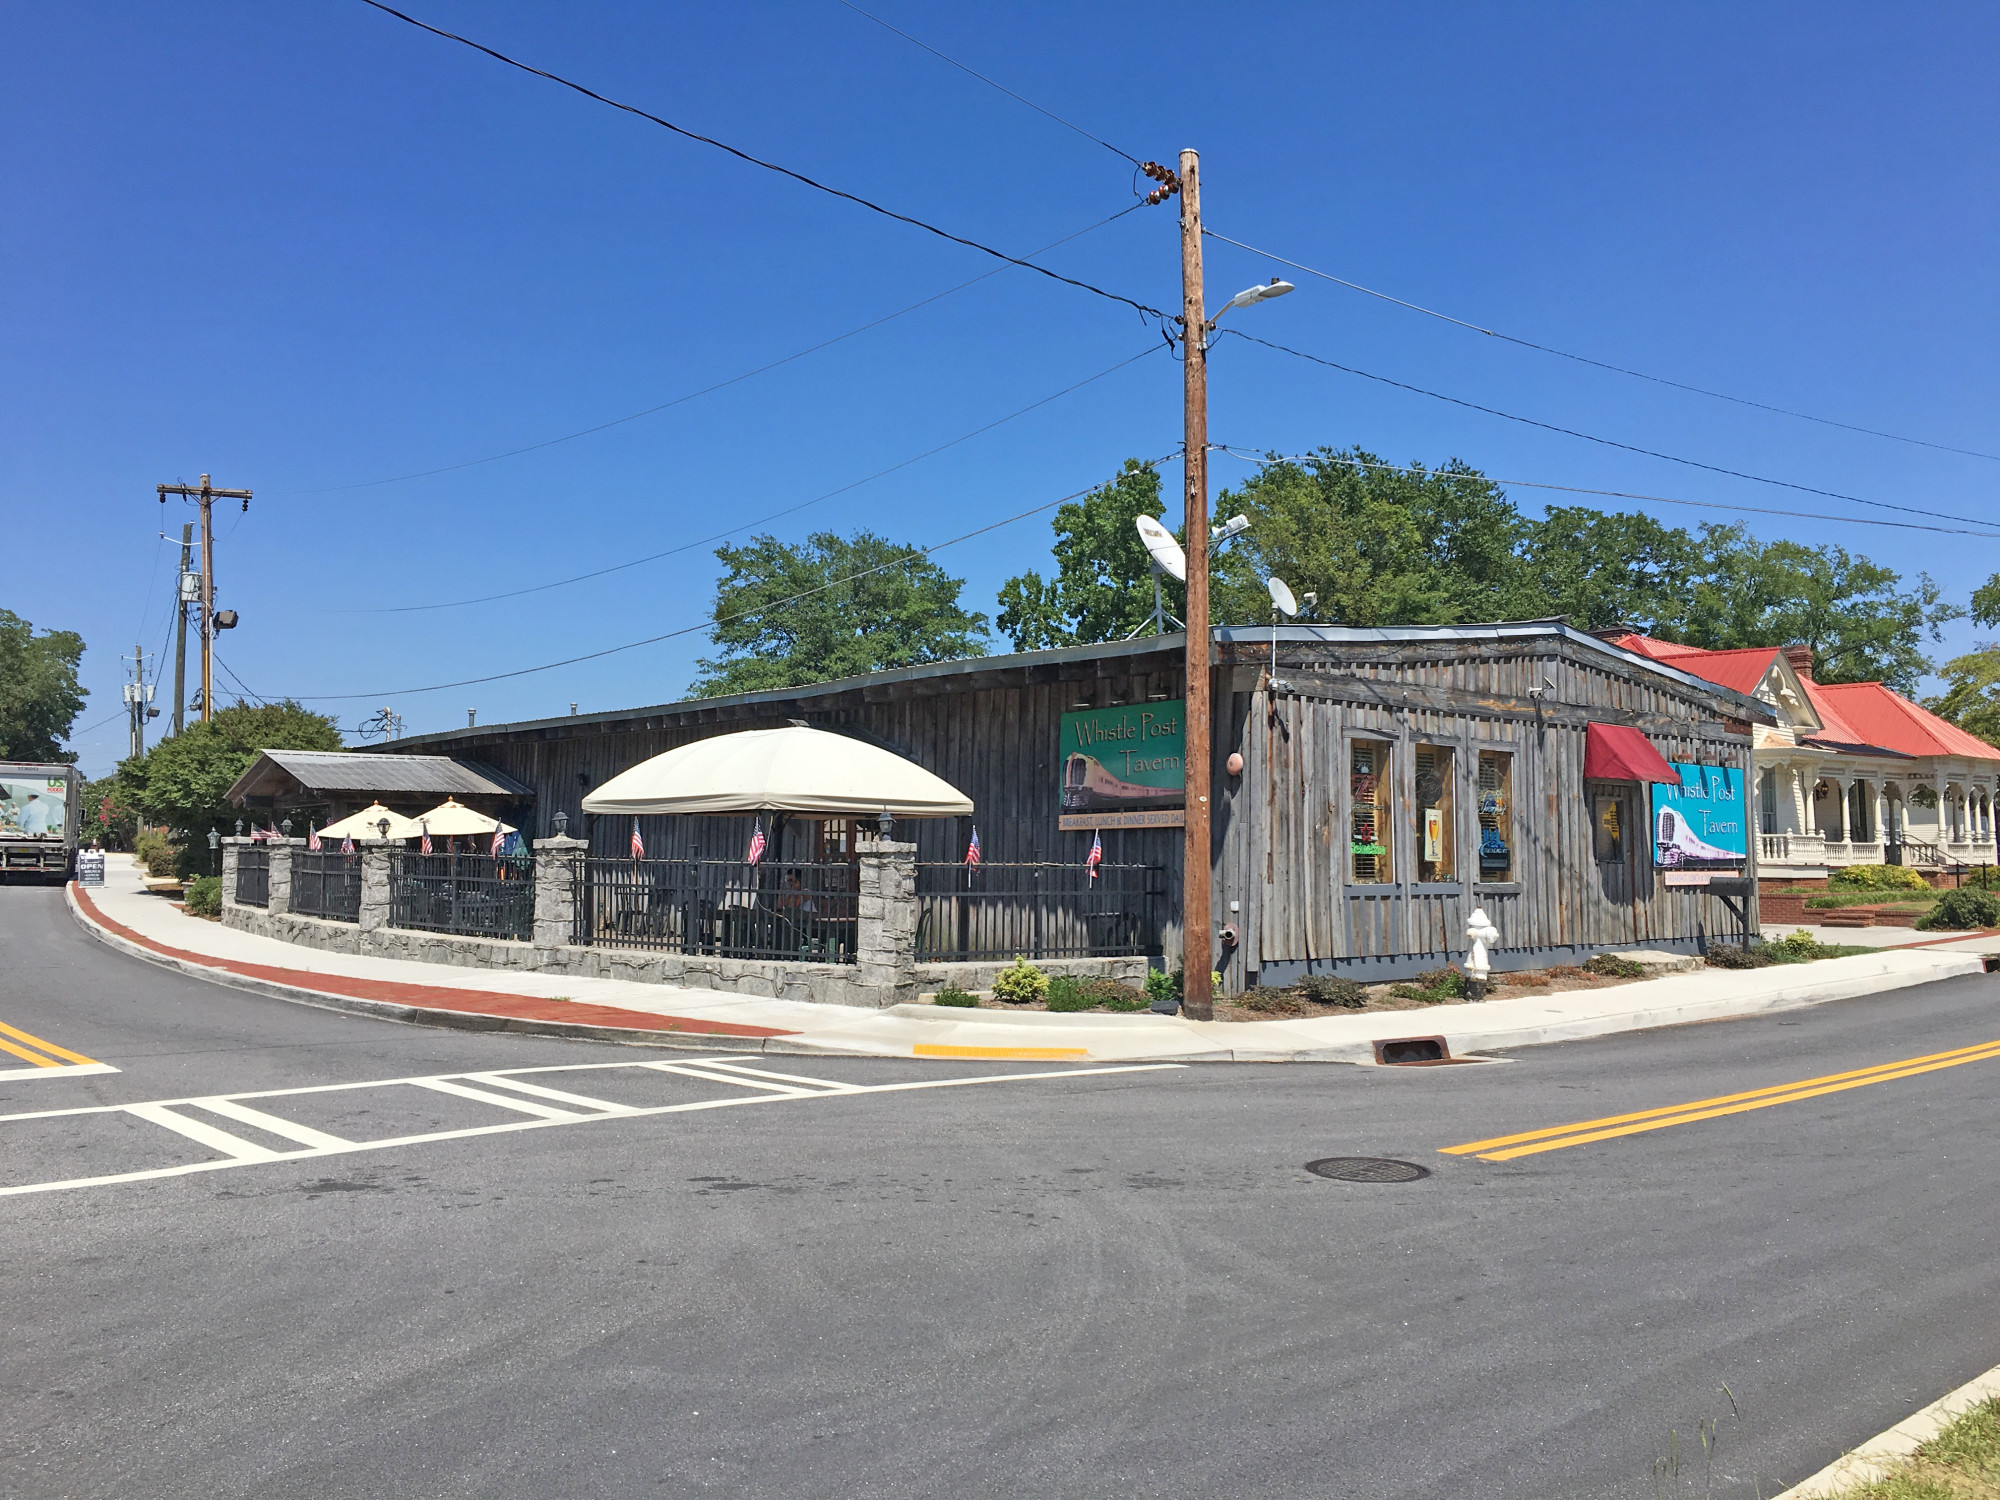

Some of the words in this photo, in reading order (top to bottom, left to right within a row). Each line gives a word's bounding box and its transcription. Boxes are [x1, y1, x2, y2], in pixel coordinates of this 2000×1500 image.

[1075, 714, 1136, 748] Whistle
[1141, 712, 1178, 742] Post
[1119, 749, 1180, 777] Tavern
[1711, 775, 1736, 804] Post
[1123, 814, 1146, 825] DINNER
[1147, 813, 1169, 824] SERVED
[1698, 809, 1738, 837] Tavern
